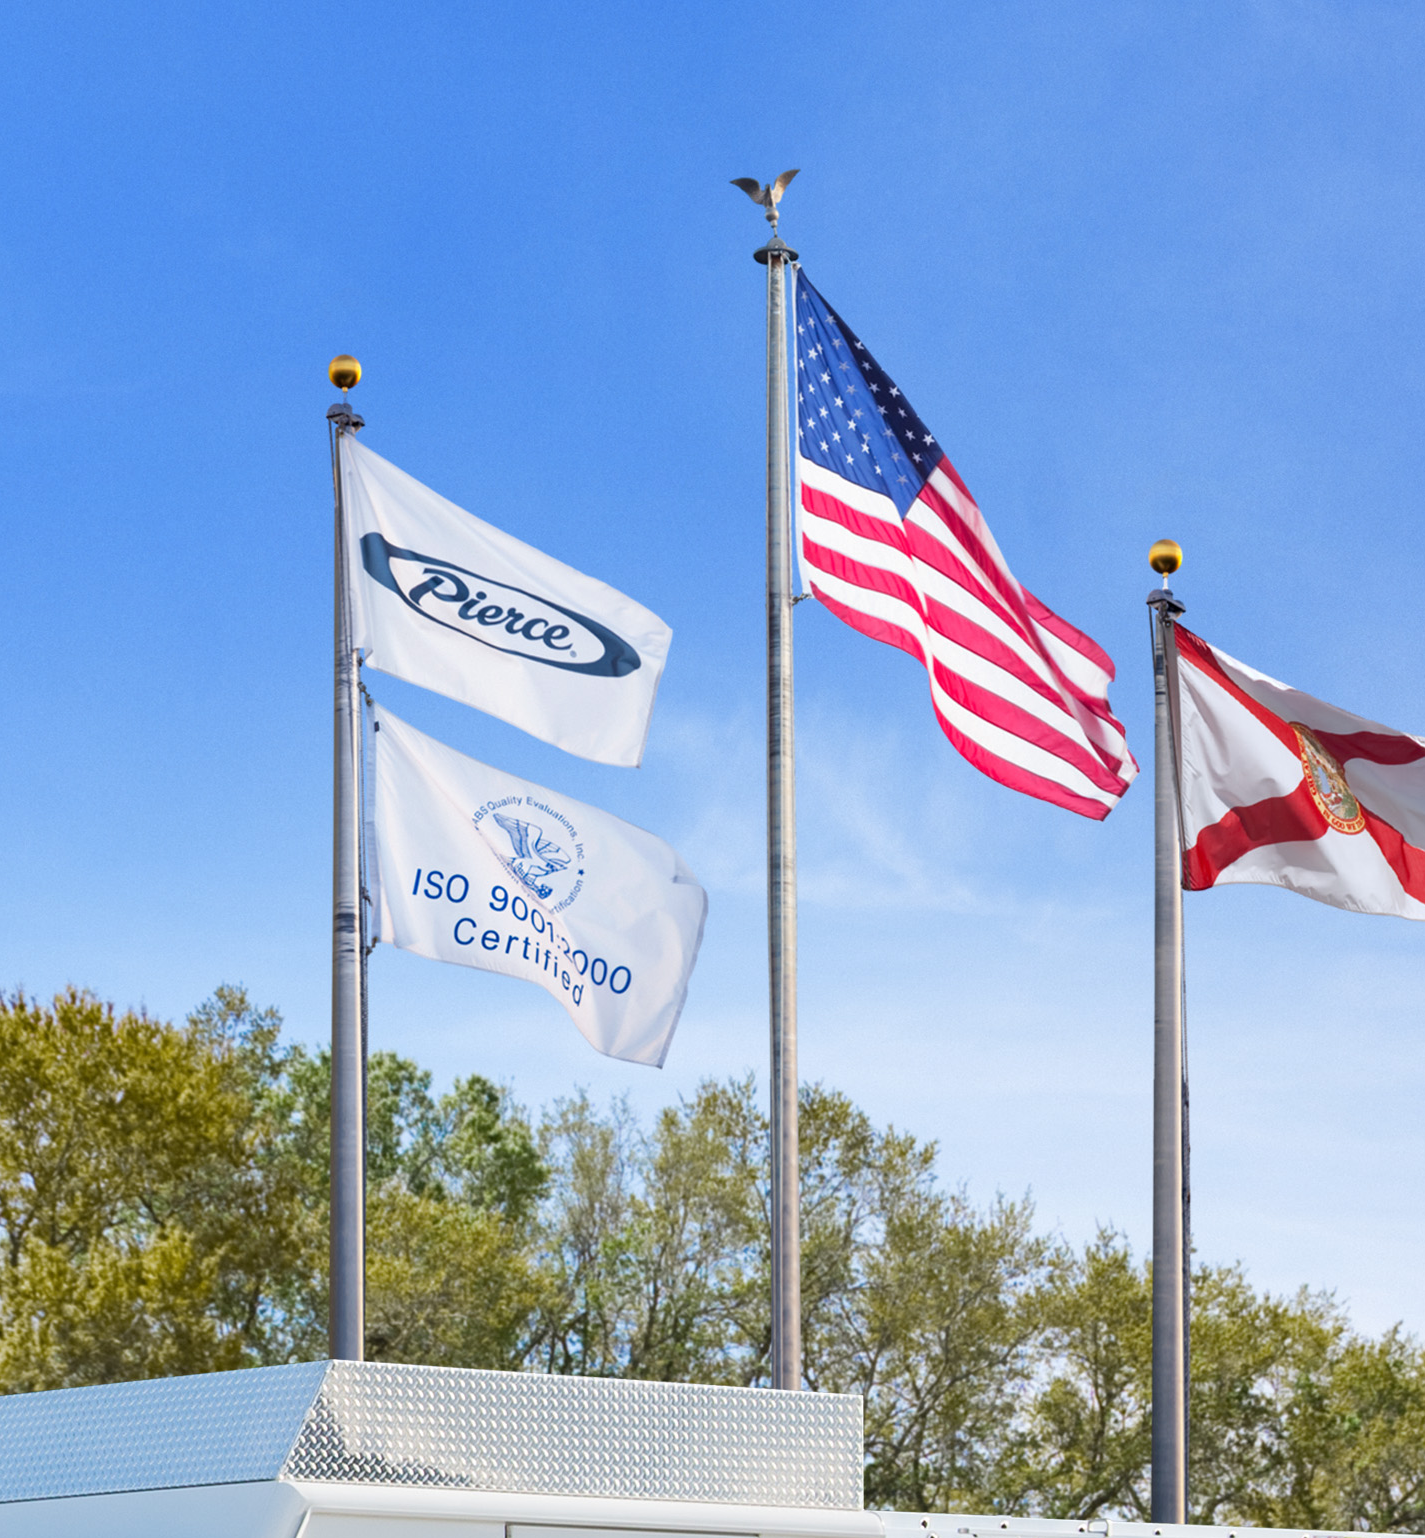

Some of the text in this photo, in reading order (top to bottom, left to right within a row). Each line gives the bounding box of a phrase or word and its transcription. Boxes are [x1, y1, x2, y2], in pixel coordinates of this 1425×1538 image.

[409, 567, 574, 651] Pierce
[487, 796, 523, 811] Quality
[412, 868, 470, 904] ISO
[489, 885, 632, 995] 9001:2000
[453, 917, 584, 1007] Certified
